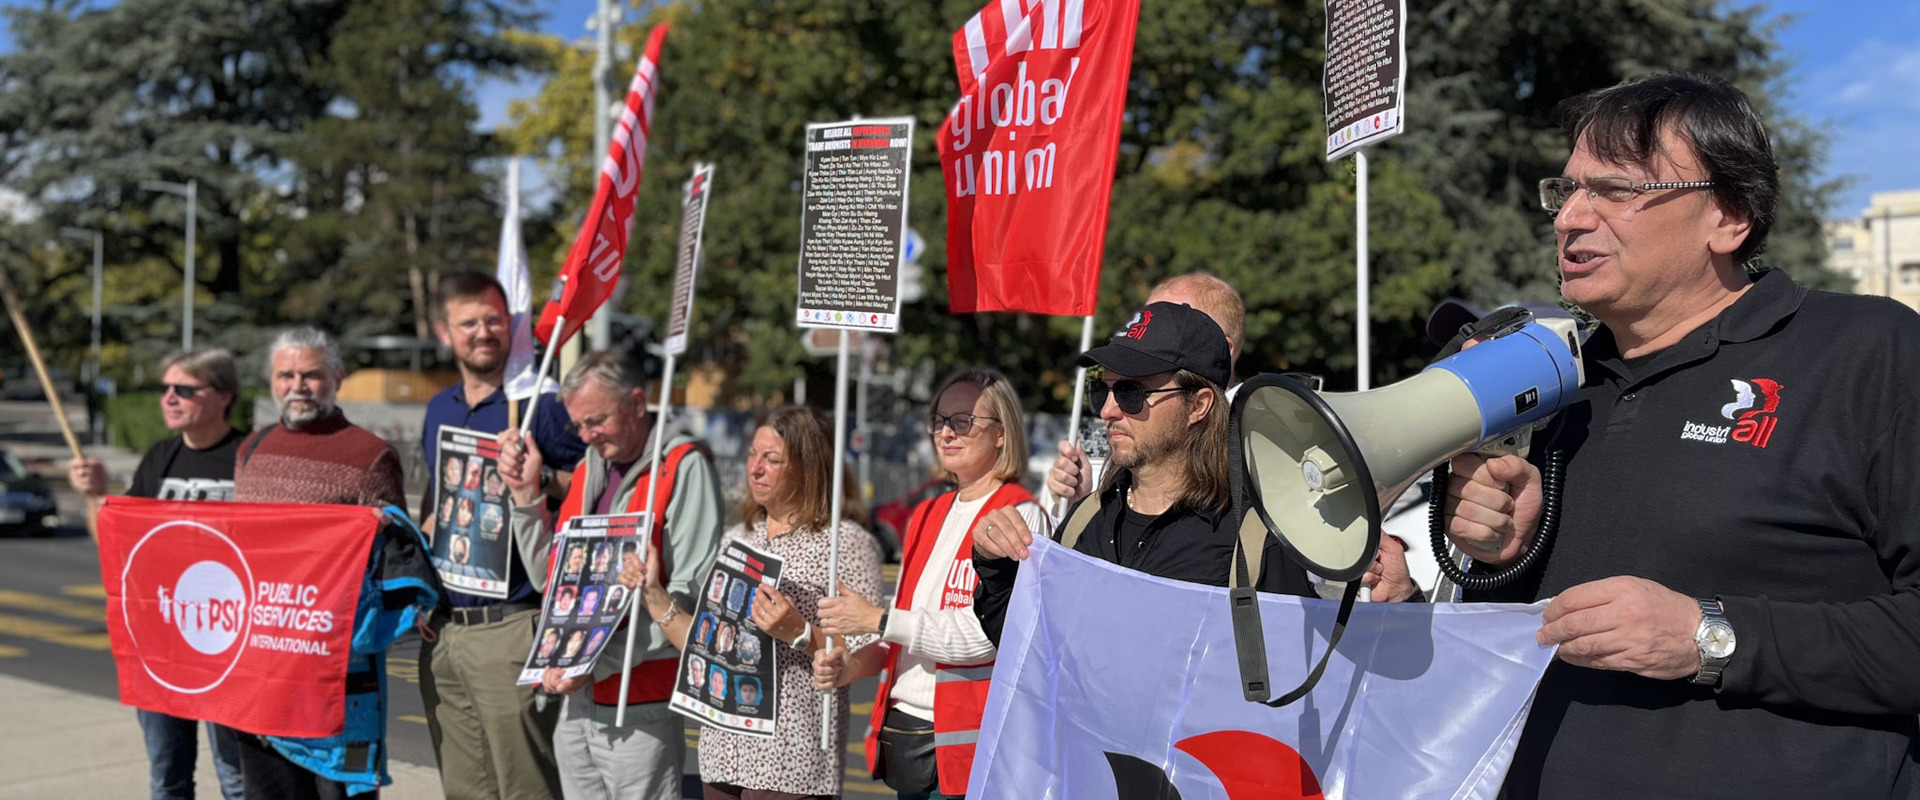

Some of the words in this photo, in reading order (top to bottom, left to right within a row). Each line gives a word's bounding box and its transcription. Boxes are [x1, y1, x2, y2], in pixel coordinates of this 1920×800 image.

[951, 57, 1080, 151] global
[1680, 432, 1705, 441] global
[1705, 434, 1727, 444] union
[1682, 420, 1731, 437] industri
[1731, 416, 1778, 448] all
[258, 582, 318, 607] PUBLIC
[945, 590, 974, 605] global
[208, 598, 244, 633] PSI
[254, 606, 333, 633] SERVICES
[250, 634, 331, 656] INTERNATIONAL
